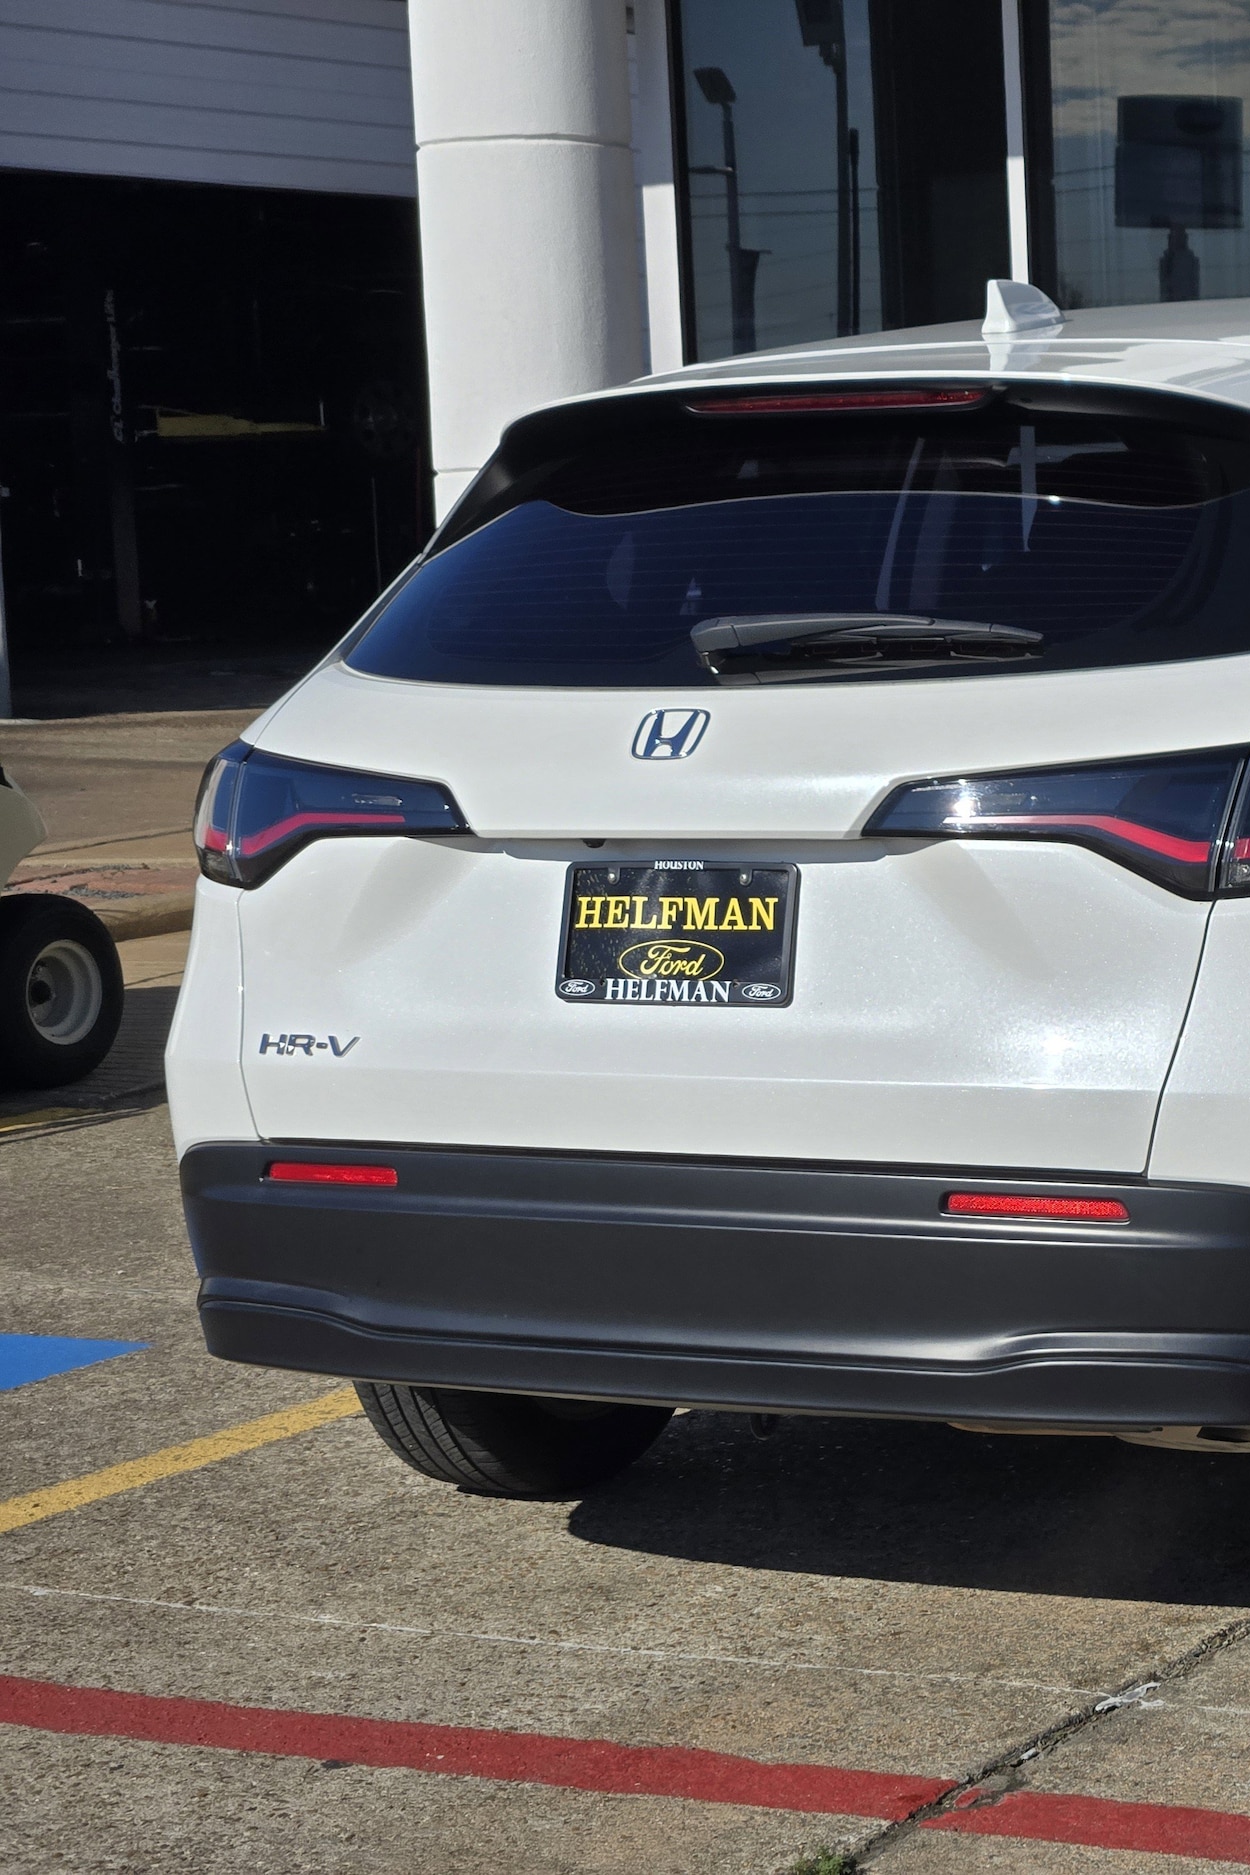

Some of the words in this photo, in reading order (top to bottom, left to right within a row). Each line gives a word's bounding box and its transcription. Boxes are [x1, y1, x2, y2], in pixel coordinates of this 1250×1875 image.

[654, 860, 704, 871] HOUSTON
[575, 896, 779, 931] HELFMAN
[639, 944, 706, 976] Ford
[565, 982, 588, 994] Ford
[604, 978, 732, 1003] HELFMAN
[748, 985, 775, 998] Ford
[259, 1033, 361, 1058] HR-V
